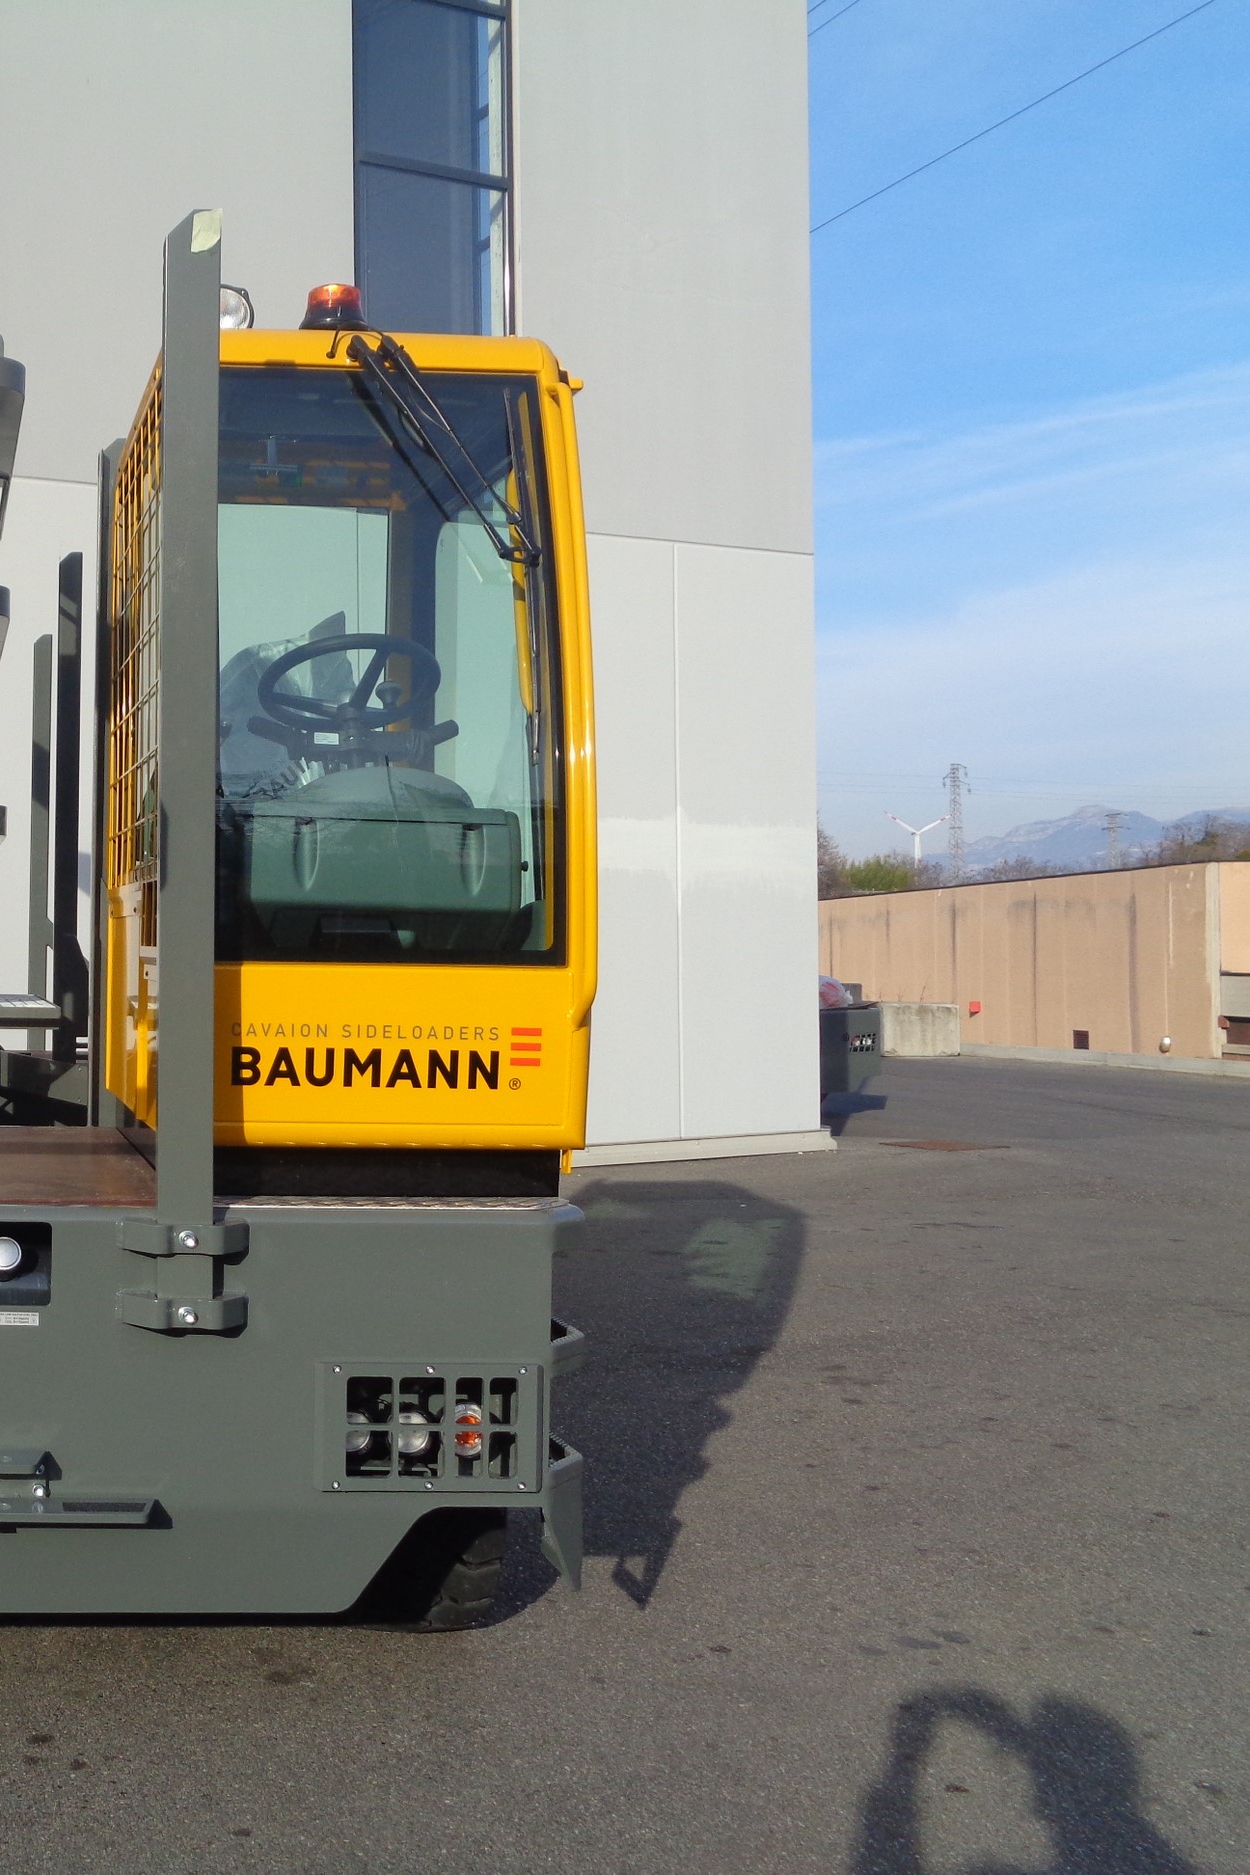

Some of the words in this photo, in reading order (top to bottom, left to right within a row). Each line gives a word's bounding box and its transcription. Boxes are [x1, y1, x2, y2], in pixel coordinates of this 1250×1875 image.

[231, 1022, 328, 1038] CAVAION
[342, 1024, 500, 1041] SIDELOADERS
[232, 1046, 499, 1090] BAUMANN
